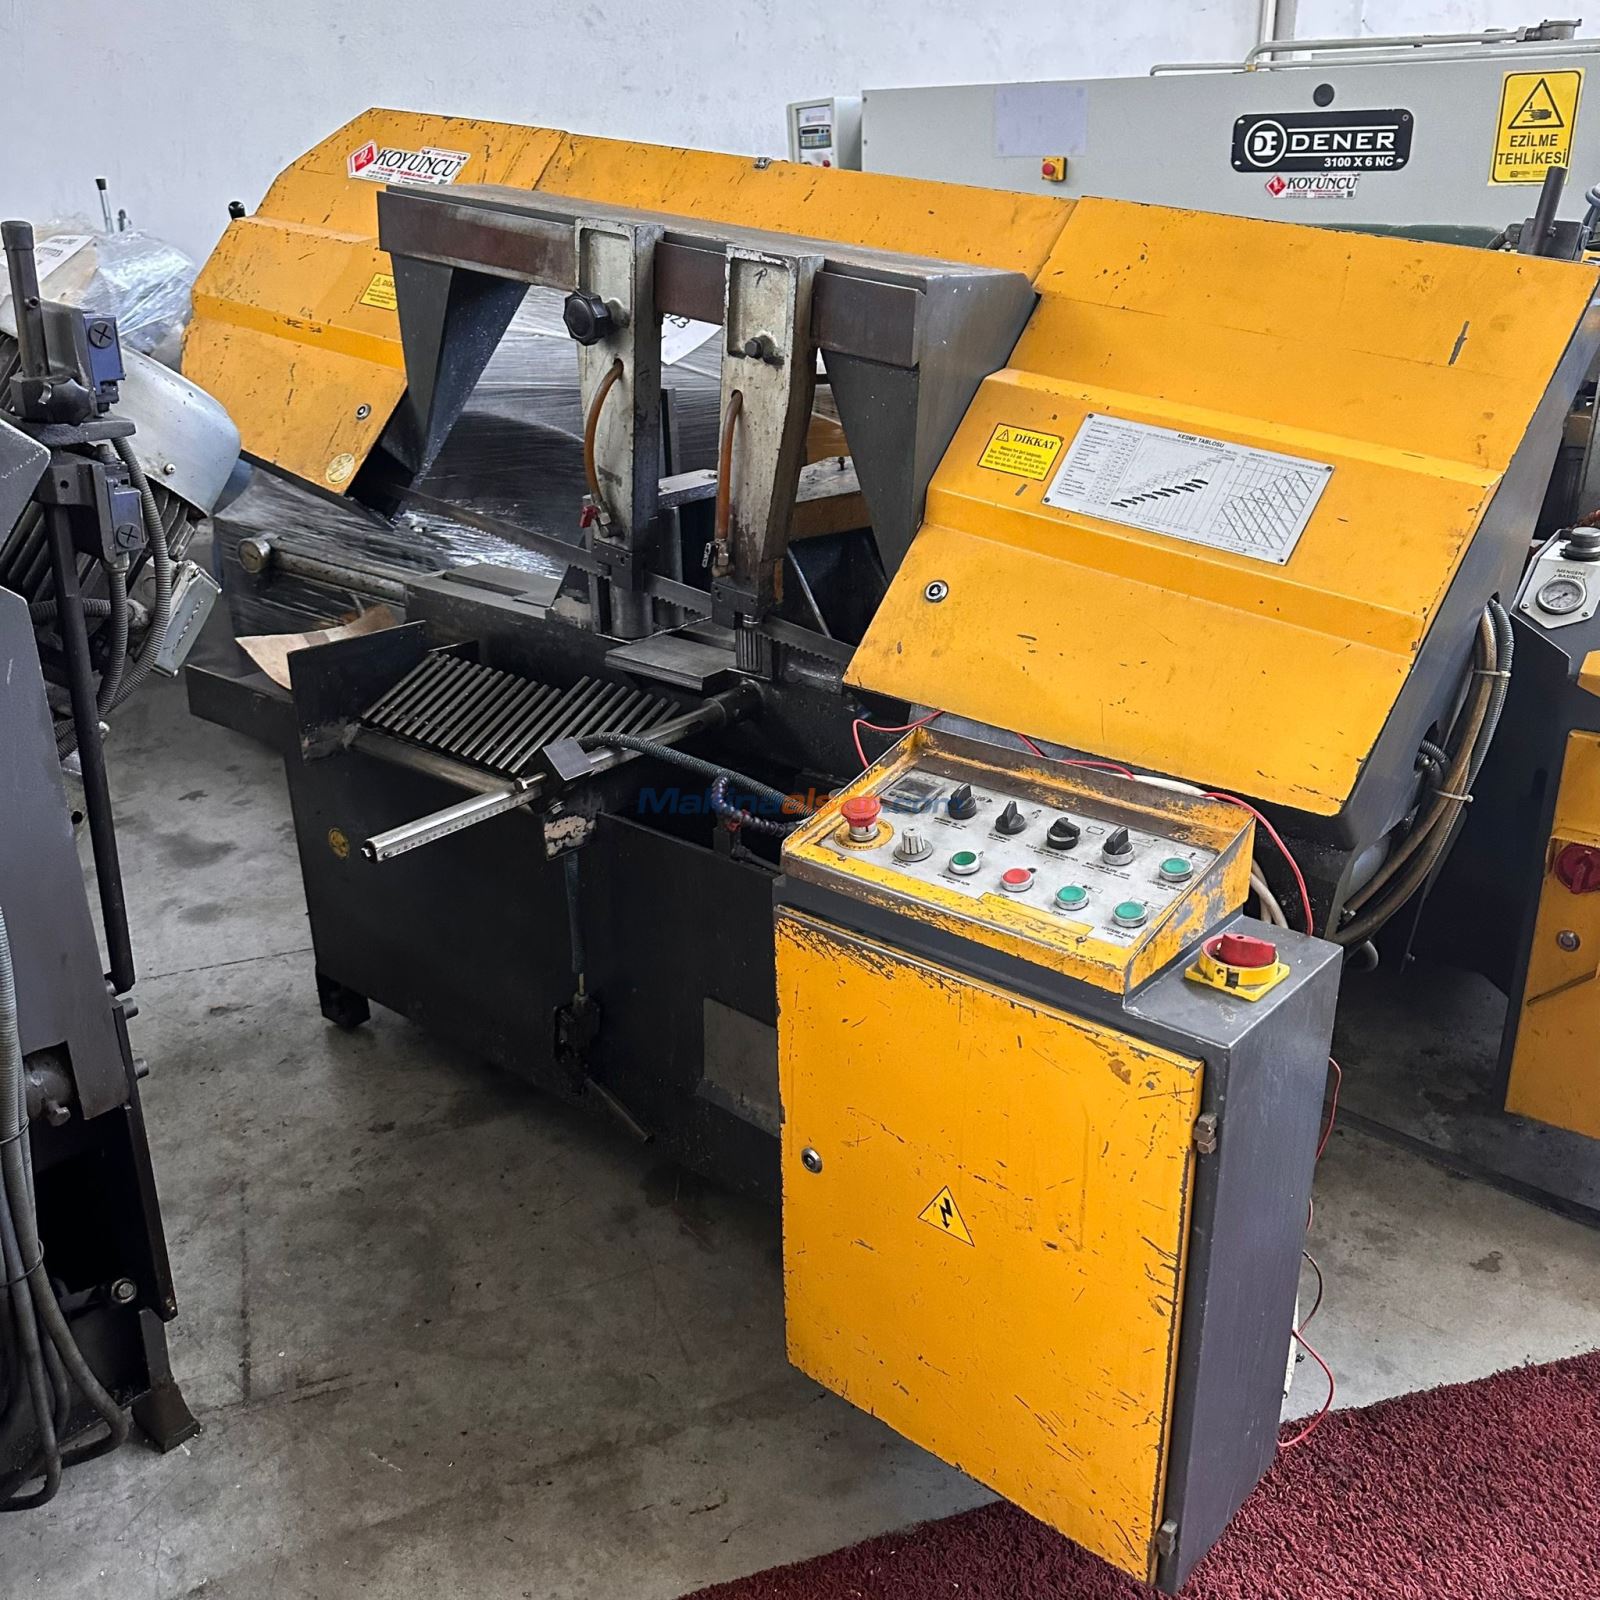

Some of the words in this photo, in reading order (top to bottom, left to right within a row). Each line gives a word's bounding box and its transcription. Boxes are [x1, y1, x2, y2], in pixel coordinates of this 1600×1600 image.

[1291, 131, 1395, 151] DENER
[1510, 132, 1559, 147] EZİLME
[374, 149, 462, 177] KOYUNCU
[1324, 158, 1351, 167] 3100
[1353, 157, 1363, 167] X
[1365, 157, 1373, 167] 6
[1375, 156, 1394, 167] NC
[1498, 148, 1567, 165] TEHLİKESİ
[1287, 177, 1358, 189] KOYUNCU
[1177, 433, 1198, 443] KESME
